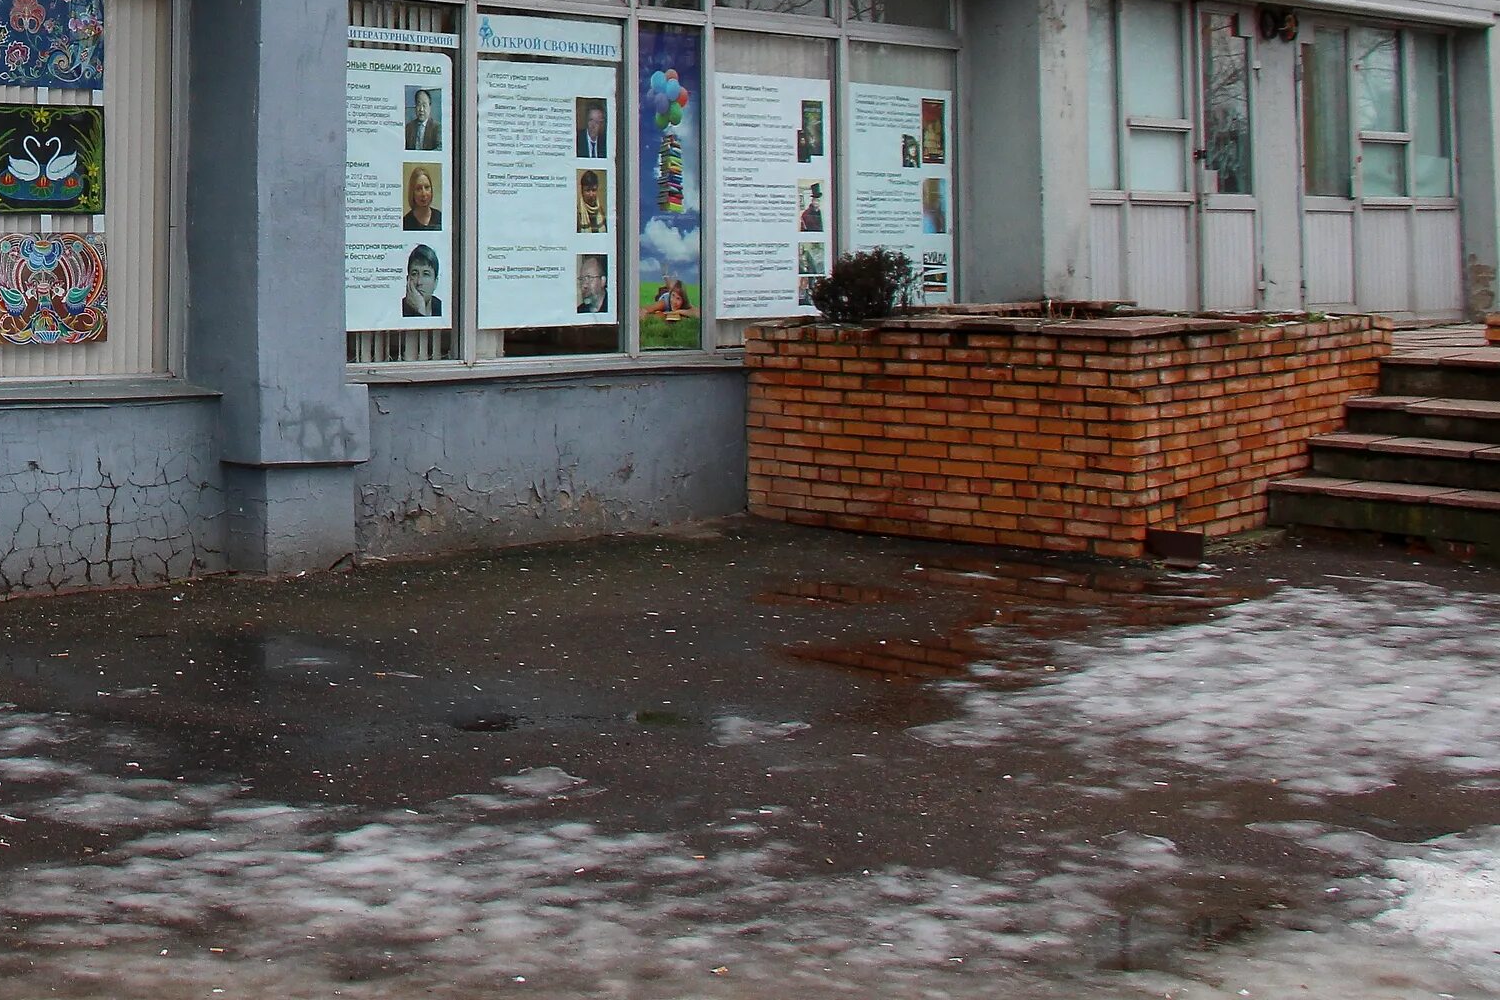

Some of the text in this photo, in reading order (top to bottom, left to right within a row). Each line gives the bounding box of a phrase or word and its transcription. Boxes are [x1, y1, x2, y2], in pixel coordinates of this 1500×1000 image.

[416, 35, 454, 46] ПРЕМИЙ
[492, 36, 618, 57] ОТКРОЙ СВОЮ КНИГУ
[369, 62, 401, 71] премии
[403, 62, 421, 72] 2012
